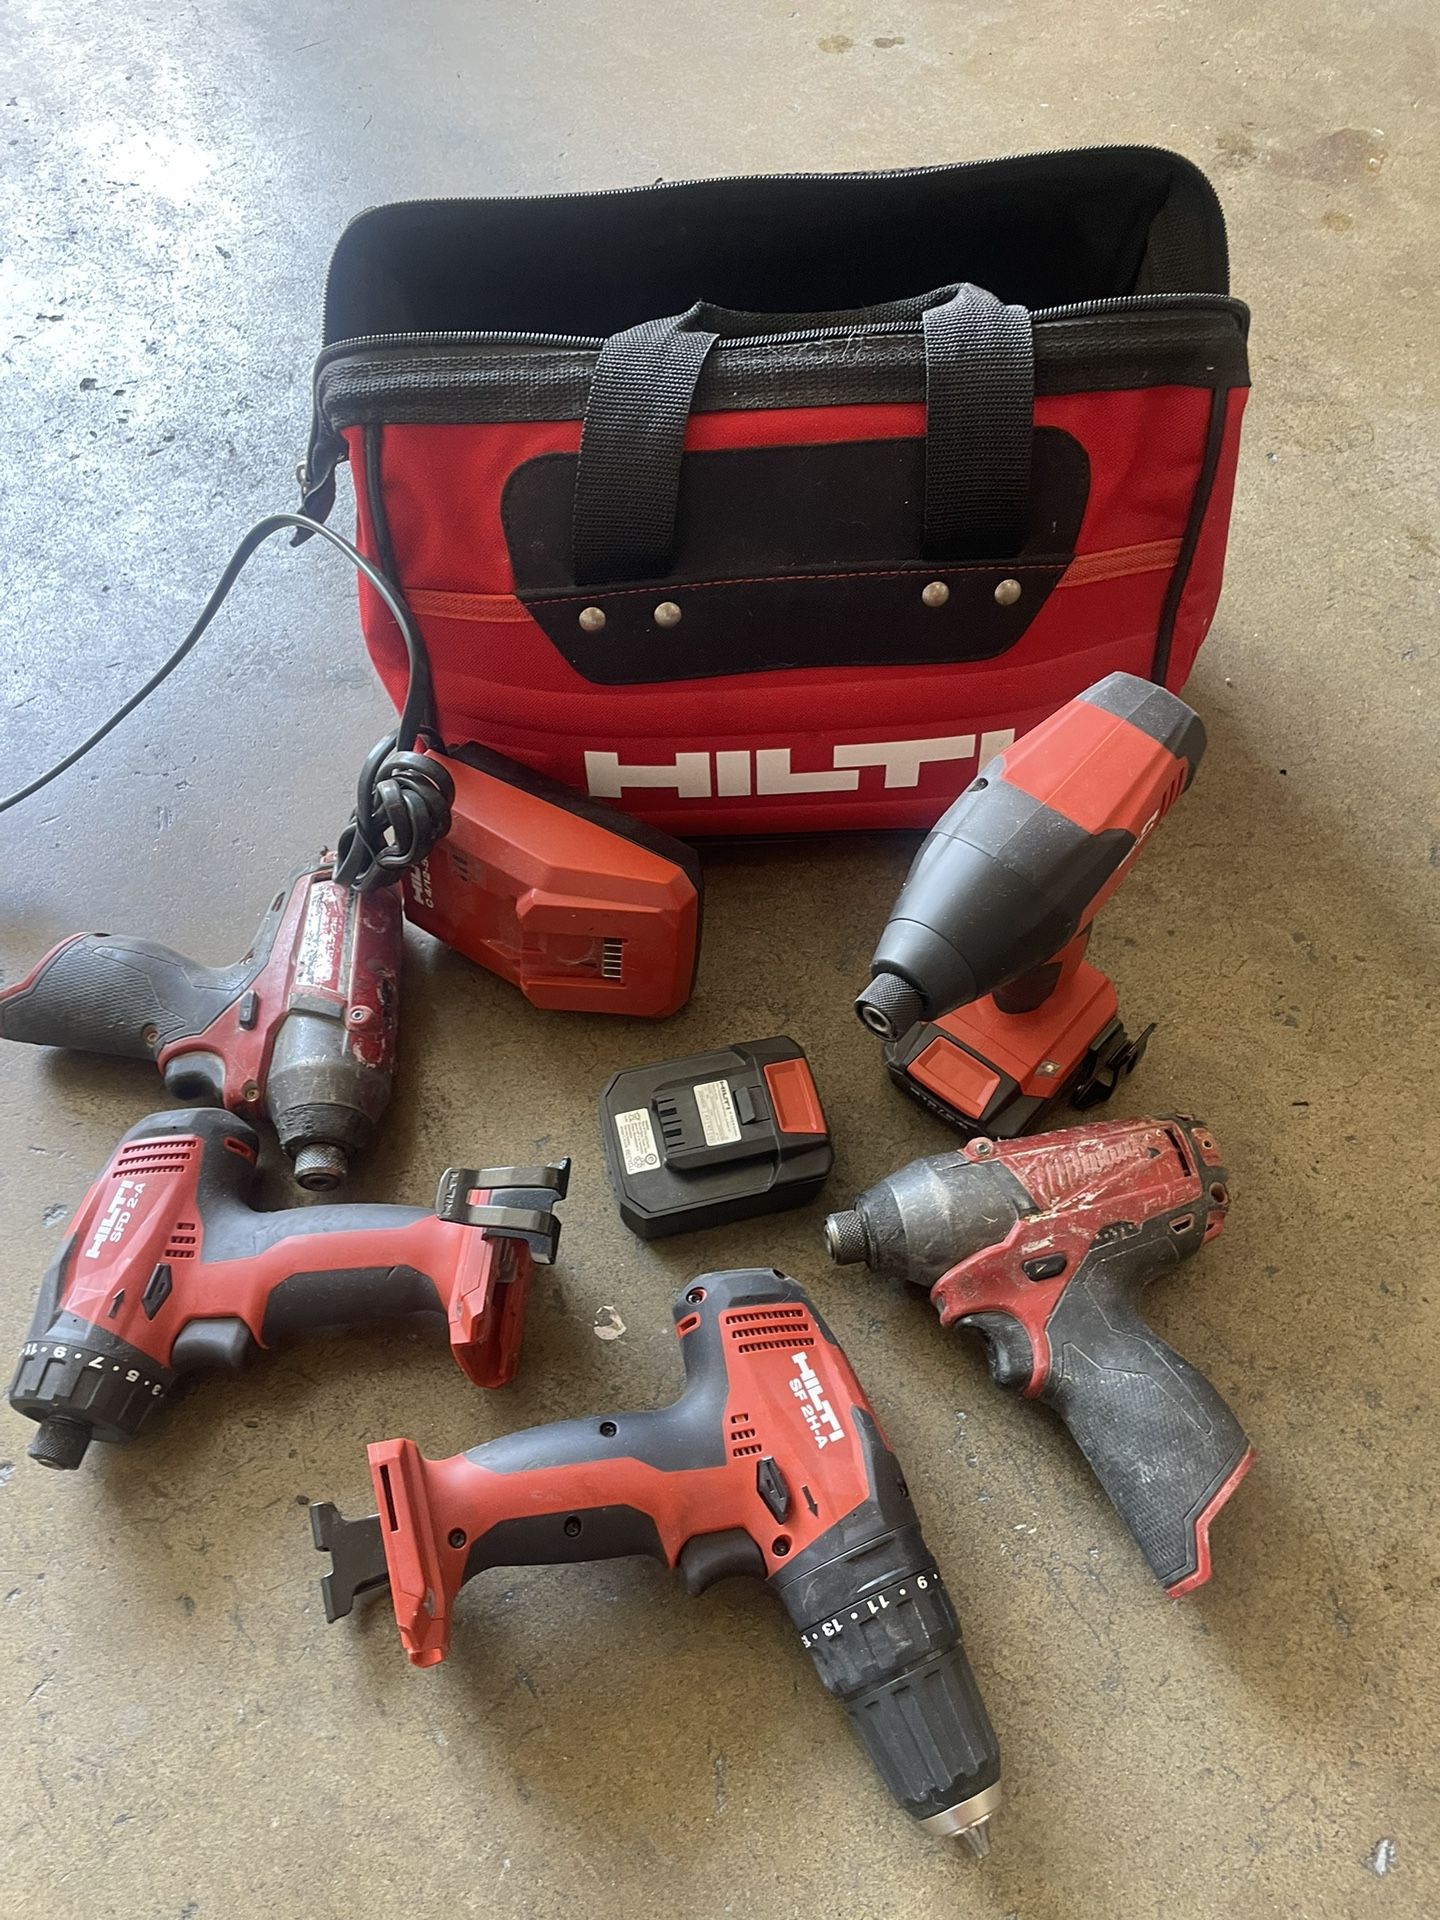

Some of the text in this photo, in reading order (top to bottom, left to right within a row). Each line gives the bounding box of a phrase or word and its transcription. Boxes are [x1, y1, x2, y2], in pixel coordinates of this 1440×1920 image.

[584, 728, 1015, 798] HILTI
[411, 864, 425, 906] HIL
[85, 1180, 134, 1258] HILTI
[110, 1183, 146, 1242] SFD 2-A
[88, 1357, 105, 1369] 7
[125, 1369, 140, 1383] 5
[151, 1384, 162, 1396] 3
[791, 1351, 845, 1442] HILTI
[788, 1378, 828, 1449] SF 2H-A
[867, 1594, 890, 1615] 11
[821, 1618, 844, 1637] 13
